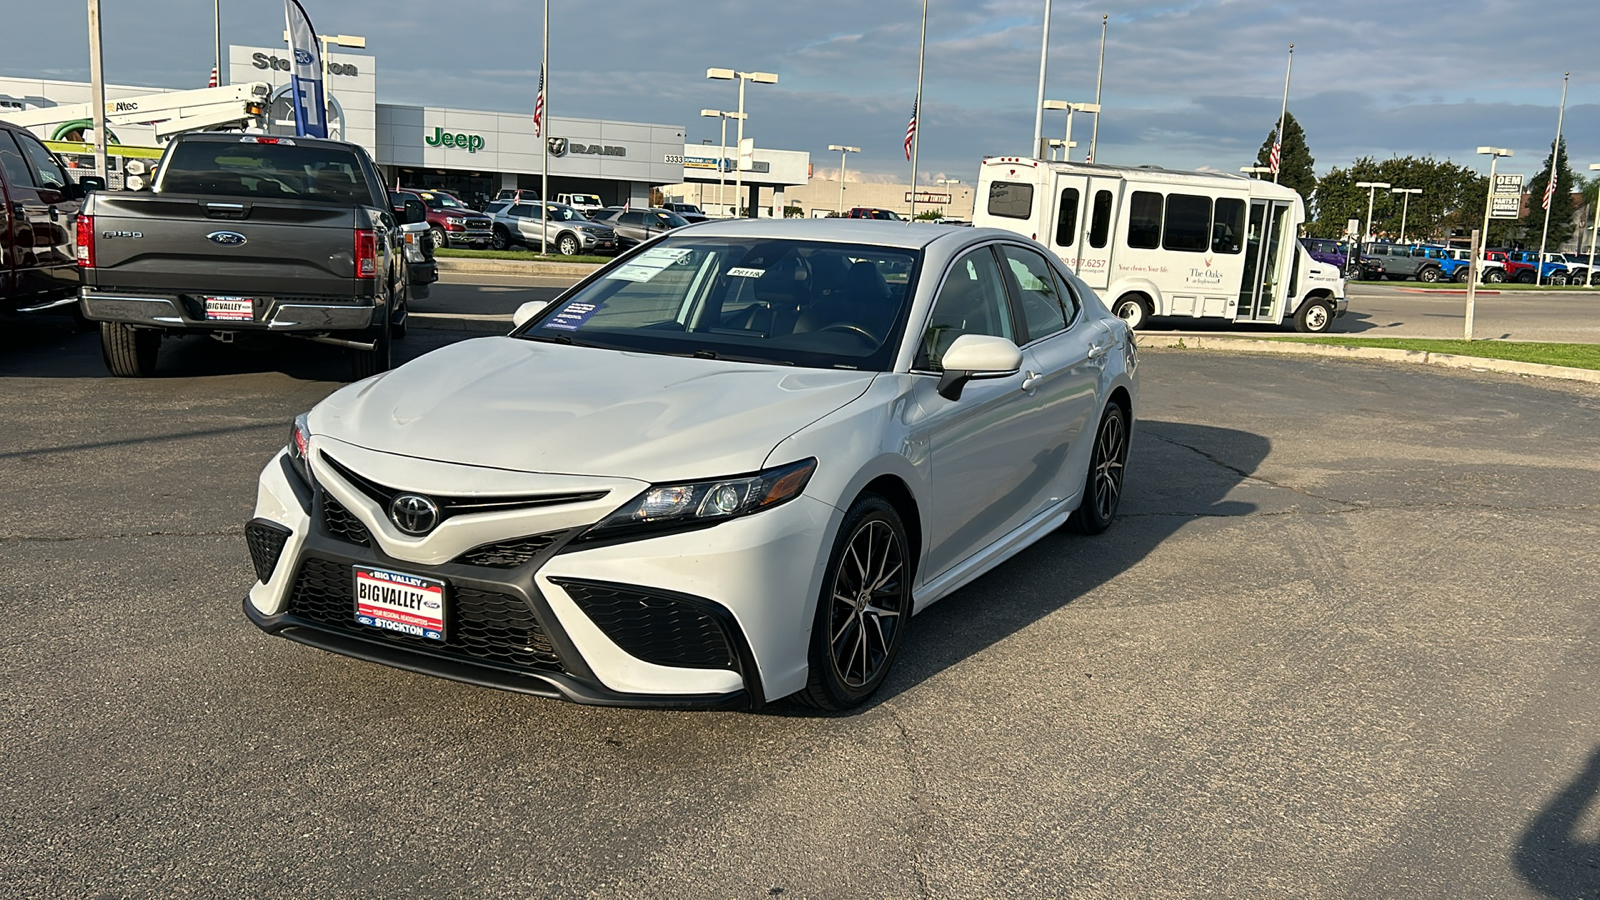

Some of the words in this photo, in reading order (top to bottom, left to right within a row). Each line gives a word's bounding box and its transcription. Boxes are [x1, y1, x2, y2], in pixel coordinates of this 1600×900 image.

[252, 52, 358, 76] Stoon
[116, 102, 138, 112] Altec
[425, 127, 482, 153] Jeep
[570, 143, 626, 156] RAM
[665, 155, 683, 163] 3333
[1497, 176, 1521, 184] OEM
[906, 194, 929, 202] WNDOW
[1190, 268, 1204, 277] The
[1205, 269, 1223, 278] Oaks
[207, 302, 242, 310] BIGVALLEY
[374, 571, 390, 580] BIG
[391, 574, 422, 587] VALLEY
[359, 582, 424, 611] BIGVALLEY
[383, 611, 400, 619] REGIONAL
[374, 618, 424, 636] STOCKTON
